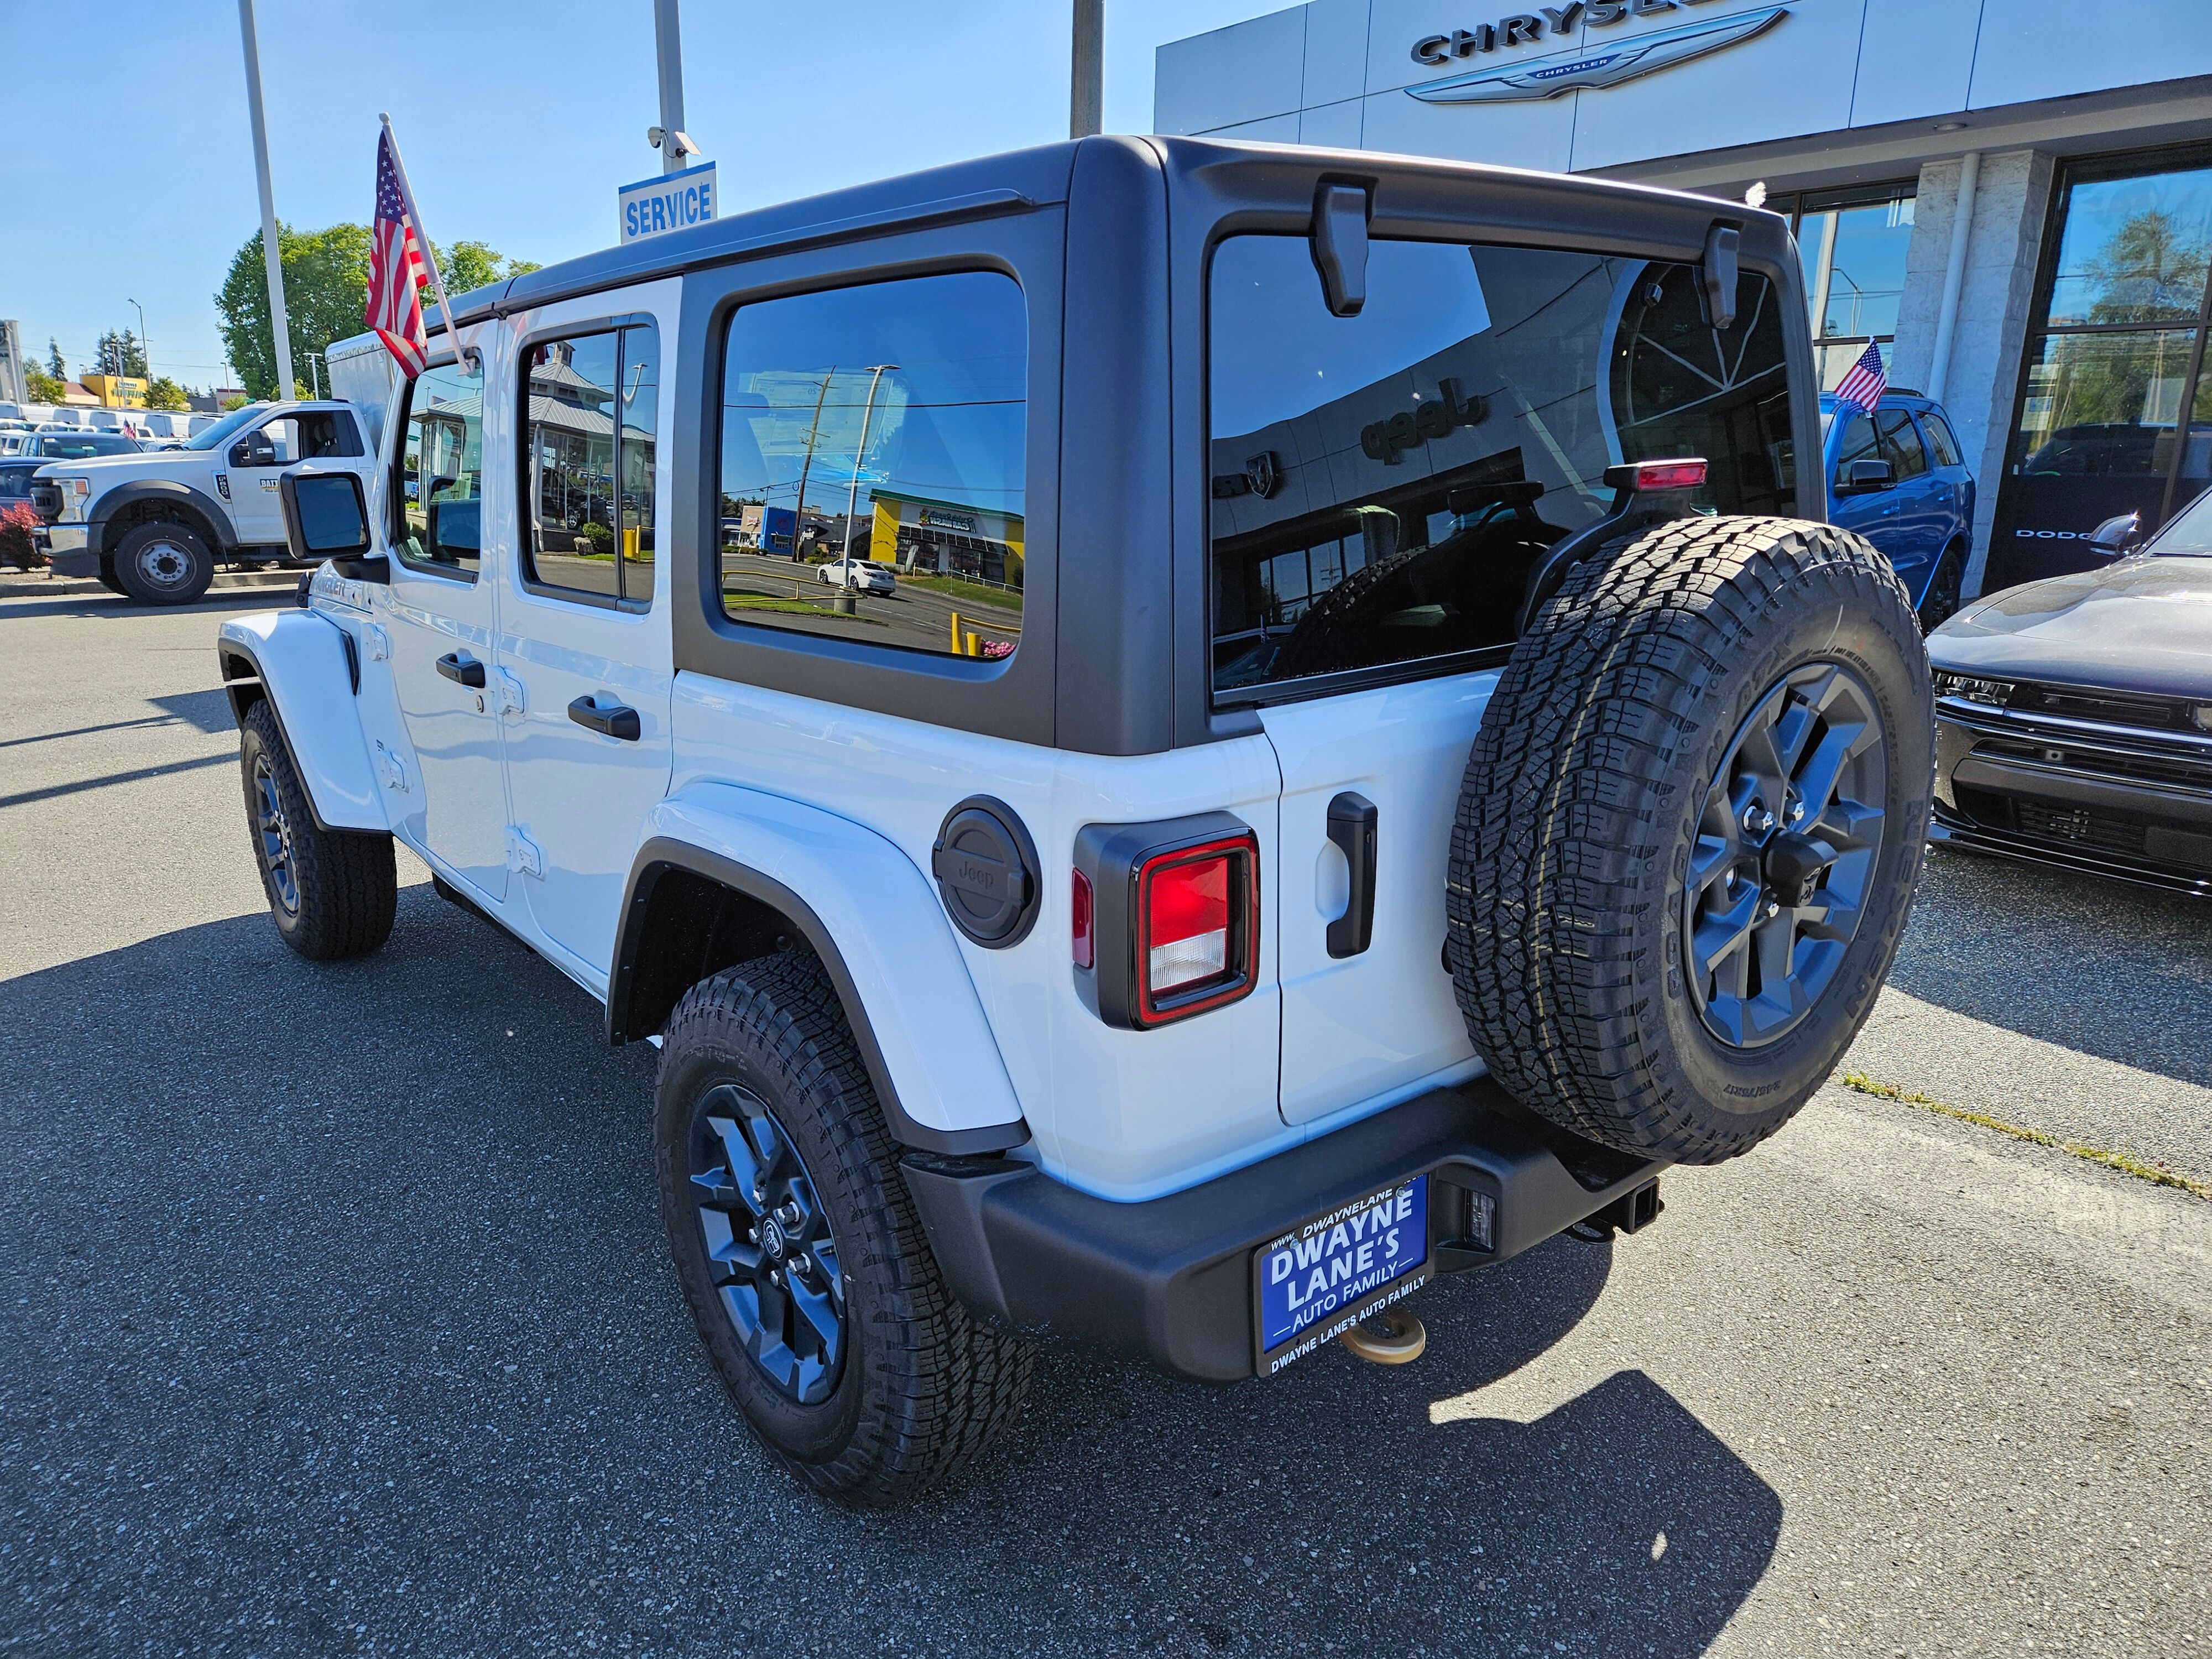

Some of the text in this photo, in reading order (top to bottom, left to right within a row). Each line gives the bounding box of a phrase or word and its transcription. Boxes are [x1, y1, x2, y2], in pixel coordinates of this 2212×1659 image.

[1411, 0, 1719, 65] CHRYSL
[1536, 59, 1608, 78] CHRYSLER
[627, 184, 711, 236] SERVICE
[2016, 530, 2092, 540] DODG
[959, 861, 994, 890] Jeep
[1845, 800, 1924, 1019] NEXEN
[1271, 1190, 1413, 1286] DWAYNE
[1302, 1188, 1393, 1239] DWAYNELANE
[1288, 1228, 1399, 1312] LANE'S
[1292, 1261, 1397, 1333] AUTO FAMILY
[1271, 1275, 1425, 1374] DWAYNE LANE'S AUTO FAMILY
